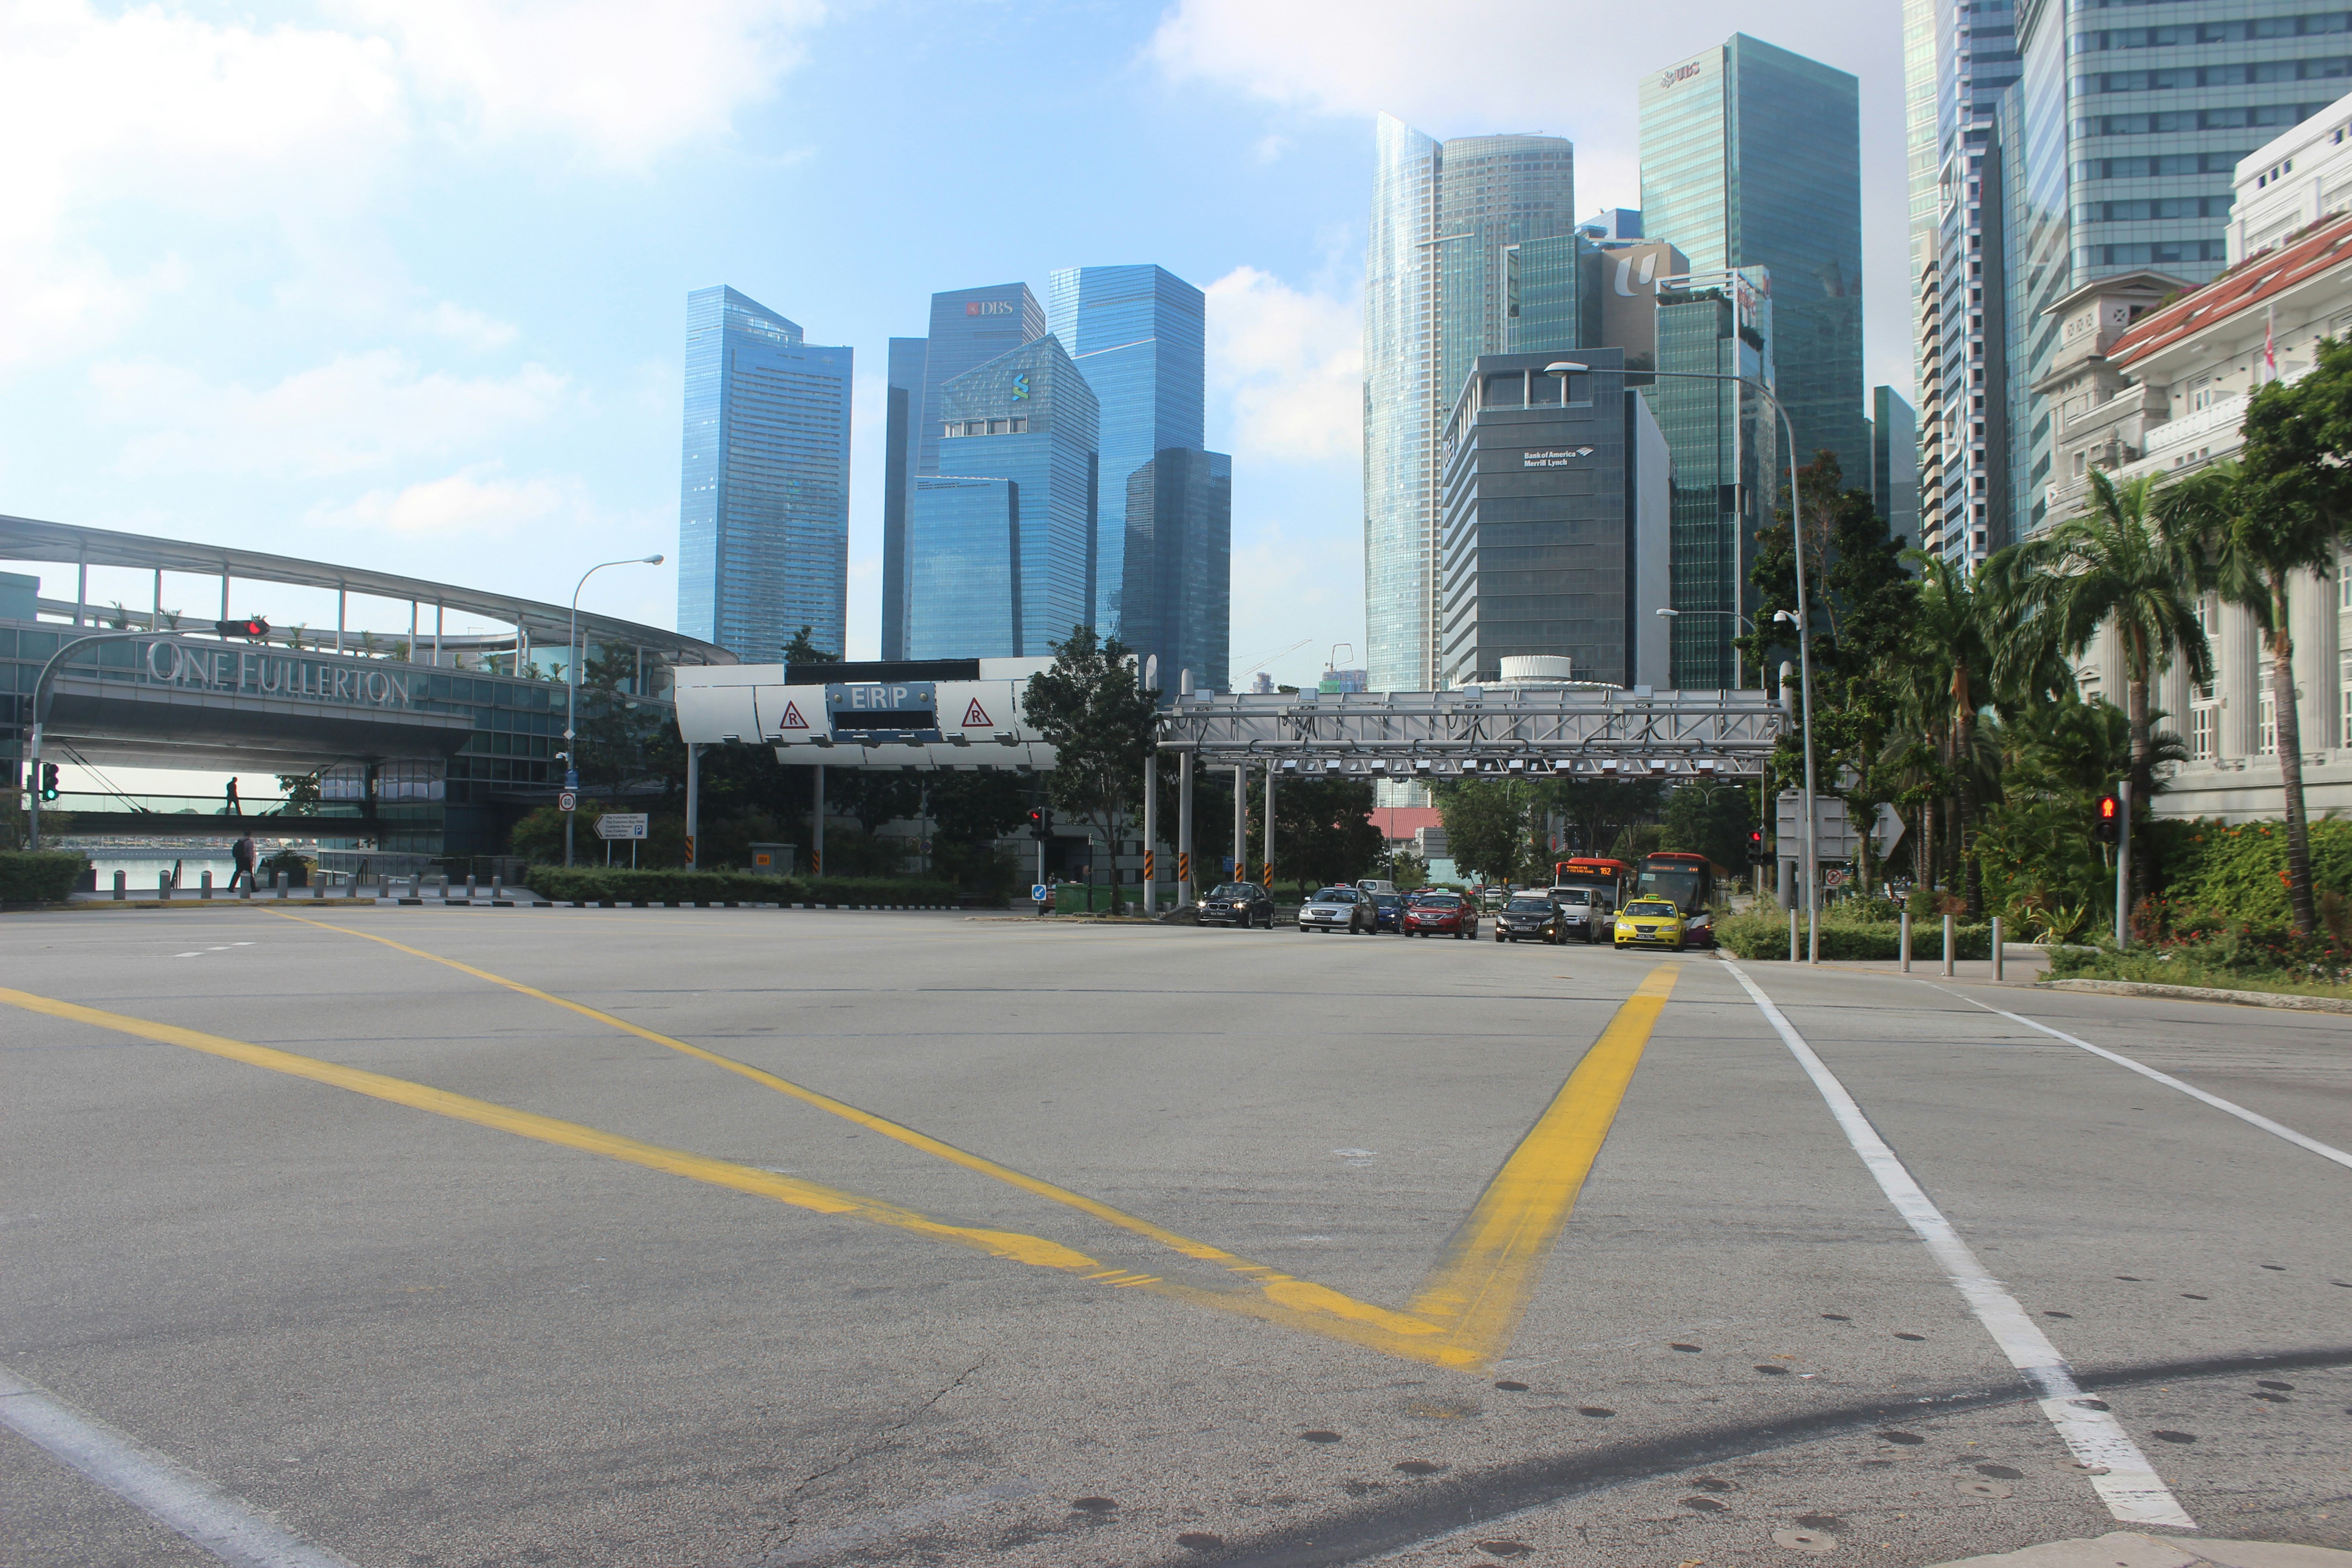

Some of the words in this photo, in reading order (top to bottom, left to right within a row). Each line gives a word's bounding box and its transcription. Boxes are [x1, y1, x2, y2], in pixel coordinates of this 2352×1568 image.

[1674, 61, 1700, 81] UBS
[981, 301, 1013, 315] DBS
[1548, 459, 1567, 467] Lynch
[147, 640, 228, 687] ONE
[239, 650, 409, 703] FULLERTON
[852, 687, 908, 709] ERP
[789, 712, 798, 725] R
[972, 710, 981, 723] R
